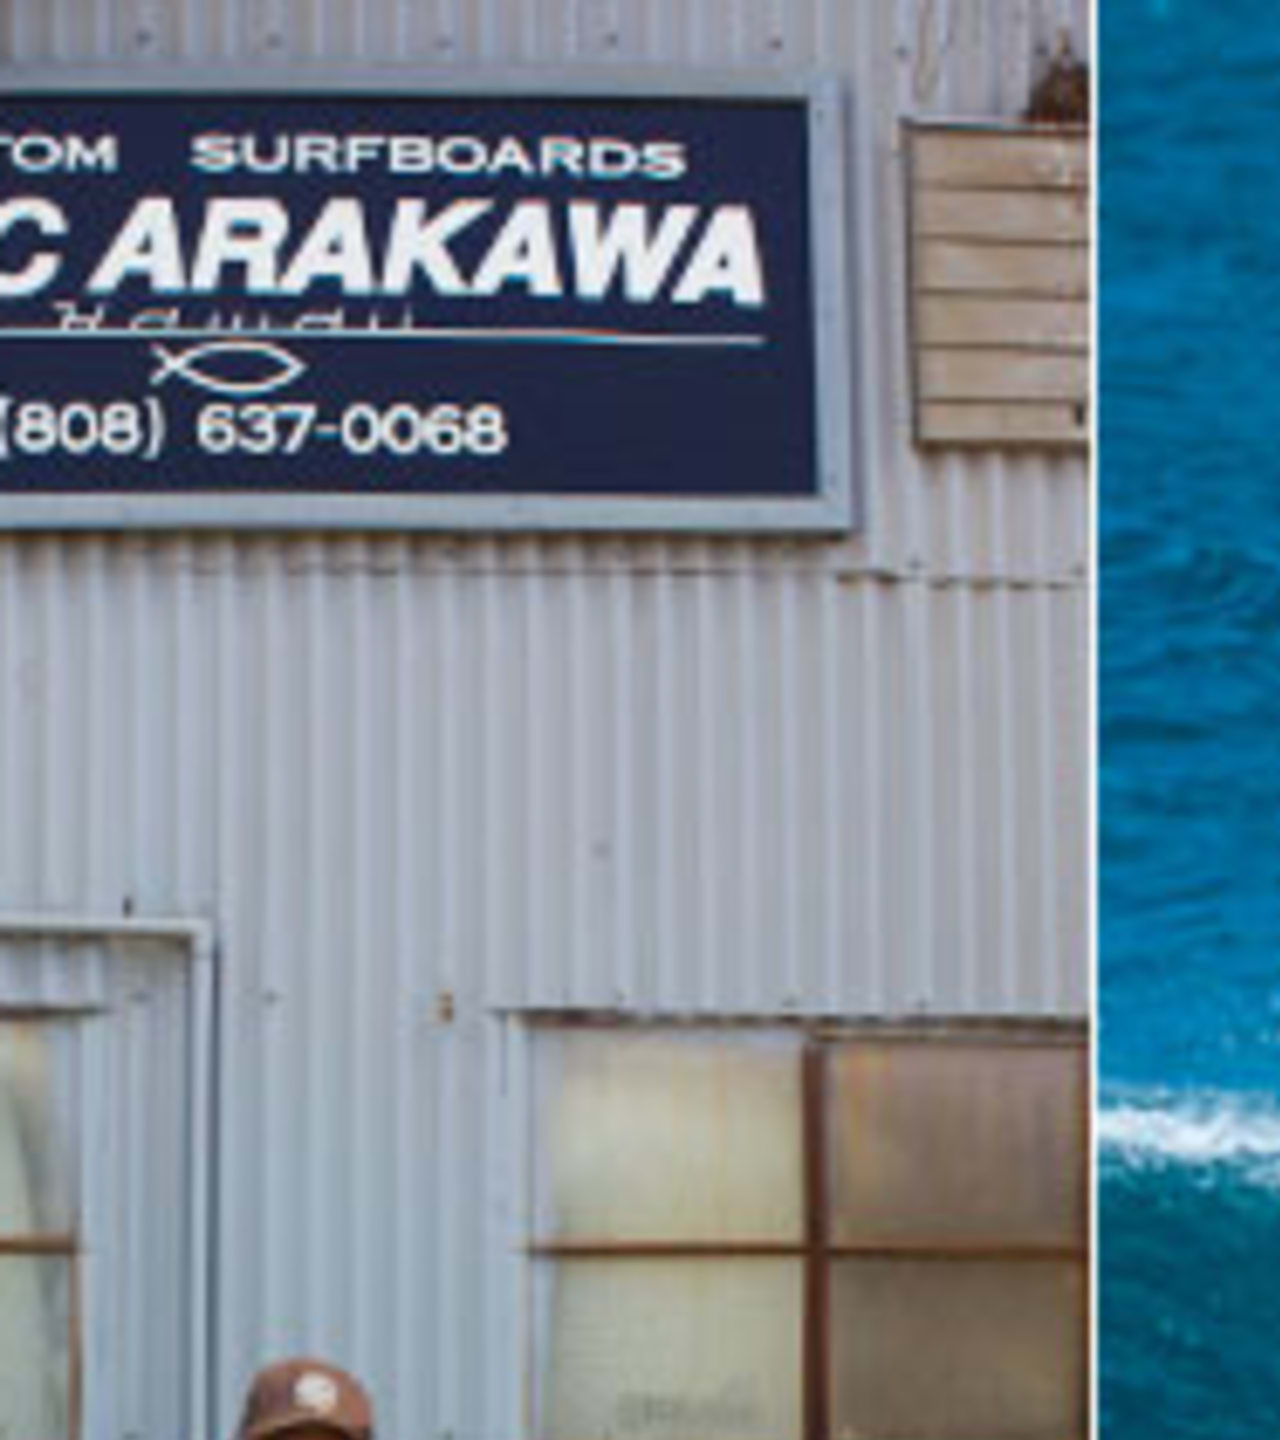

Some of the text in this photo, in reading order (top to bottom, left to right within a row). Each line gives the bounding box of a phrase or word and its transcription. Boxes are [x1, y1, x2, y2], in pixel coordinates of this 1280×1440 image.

[190, 134, 686, 179] SURFBOARDS
[86, 196, 764, 306] ARAKAWA
[0, 396, 508, 459] (808) 637-0068
